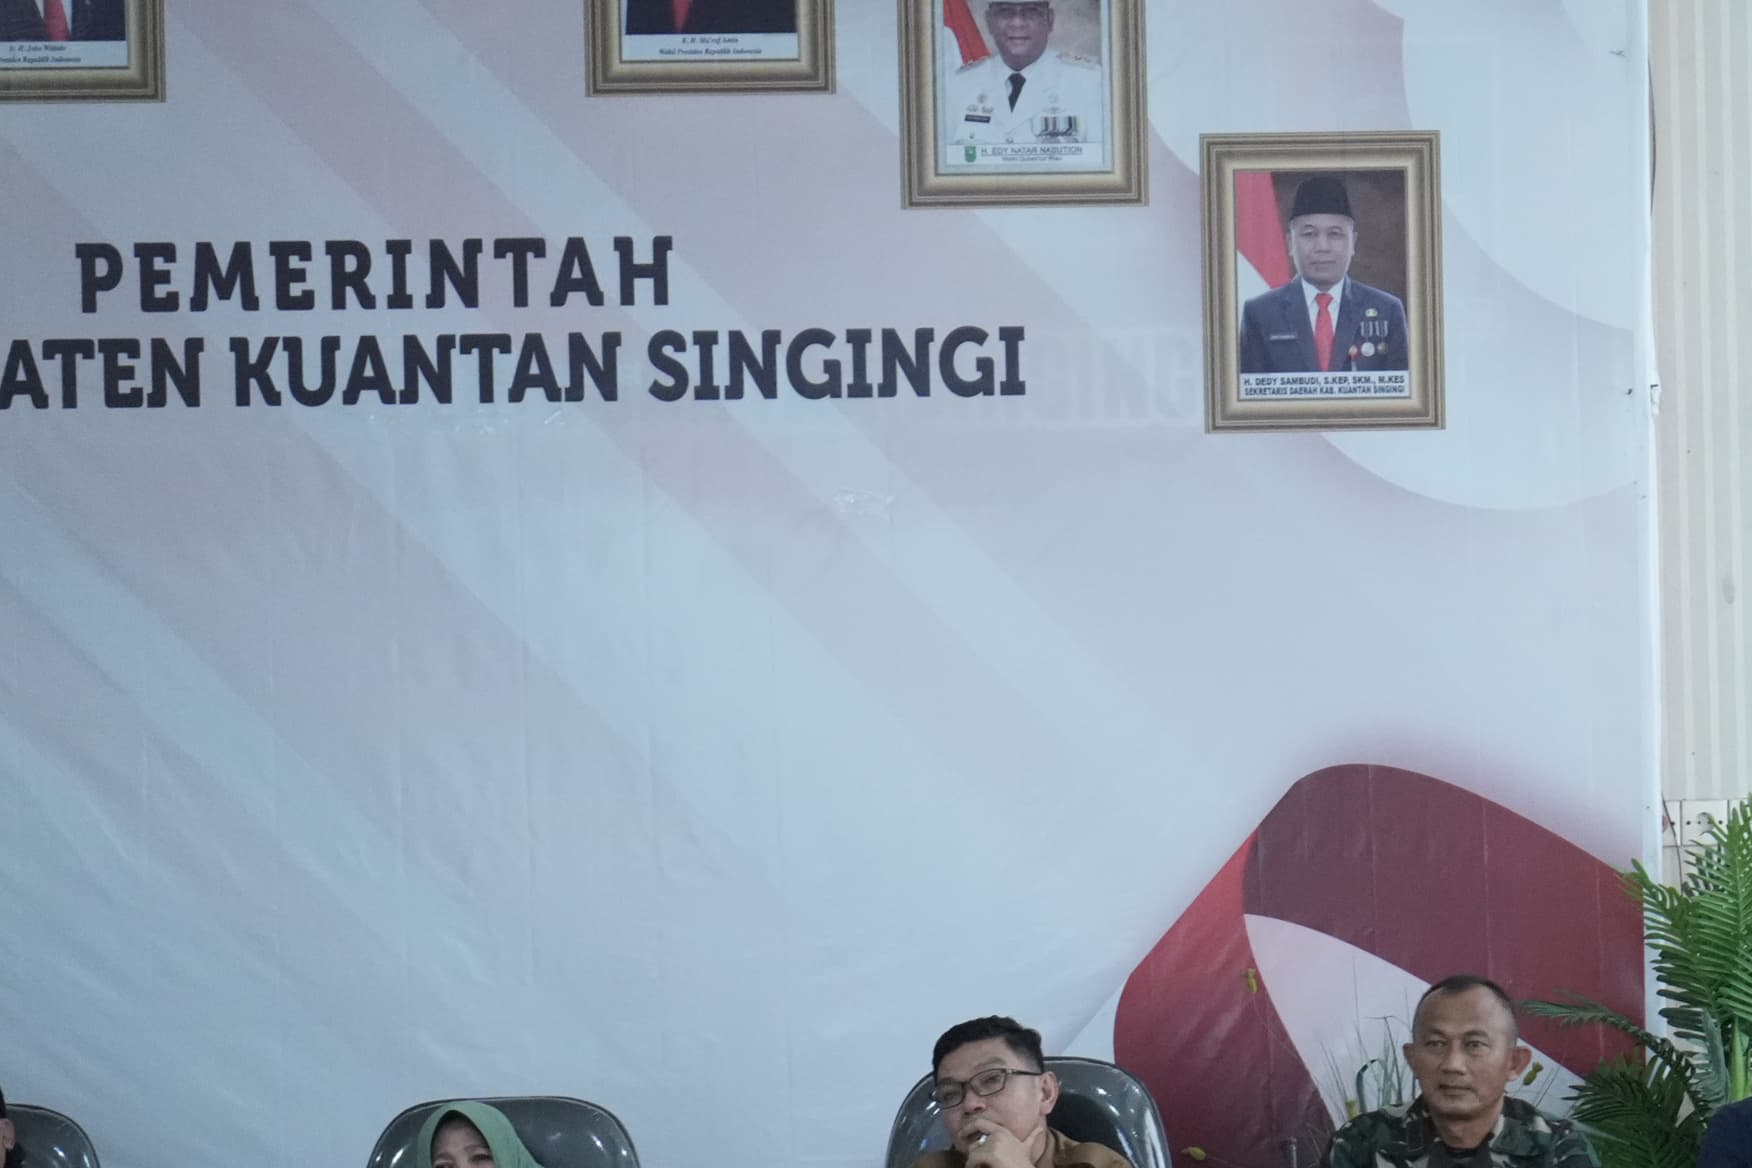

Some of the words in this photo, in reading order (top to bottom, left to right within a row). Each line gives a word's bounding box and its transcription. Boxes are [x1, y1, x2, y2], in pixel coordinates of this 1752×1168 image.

[75, 236, 673, 313] PEMERINTAH
[0, 337, 204, 410] ATEN
[231, 331, 622, 407] KUANTAN
[647, 325, 1026, 401] SINGINGI
[1244, 377, 1254, 386] H.
[1256, 377, 1277, 386] DEDY
[1280, 376, 1321, 387] SAMBUDI,
[1378, 375, 1405, 385] M.KES
[1244, 387, 1288, 396] SEKRETARIS
[1289, 386, 1318, 395] DAERAH
[1320, 386, 1334, 395] KAB.
[1338, 385, 1371, 394] KUANTAN
[1374, 385, 1405, 394] SINGINGI
